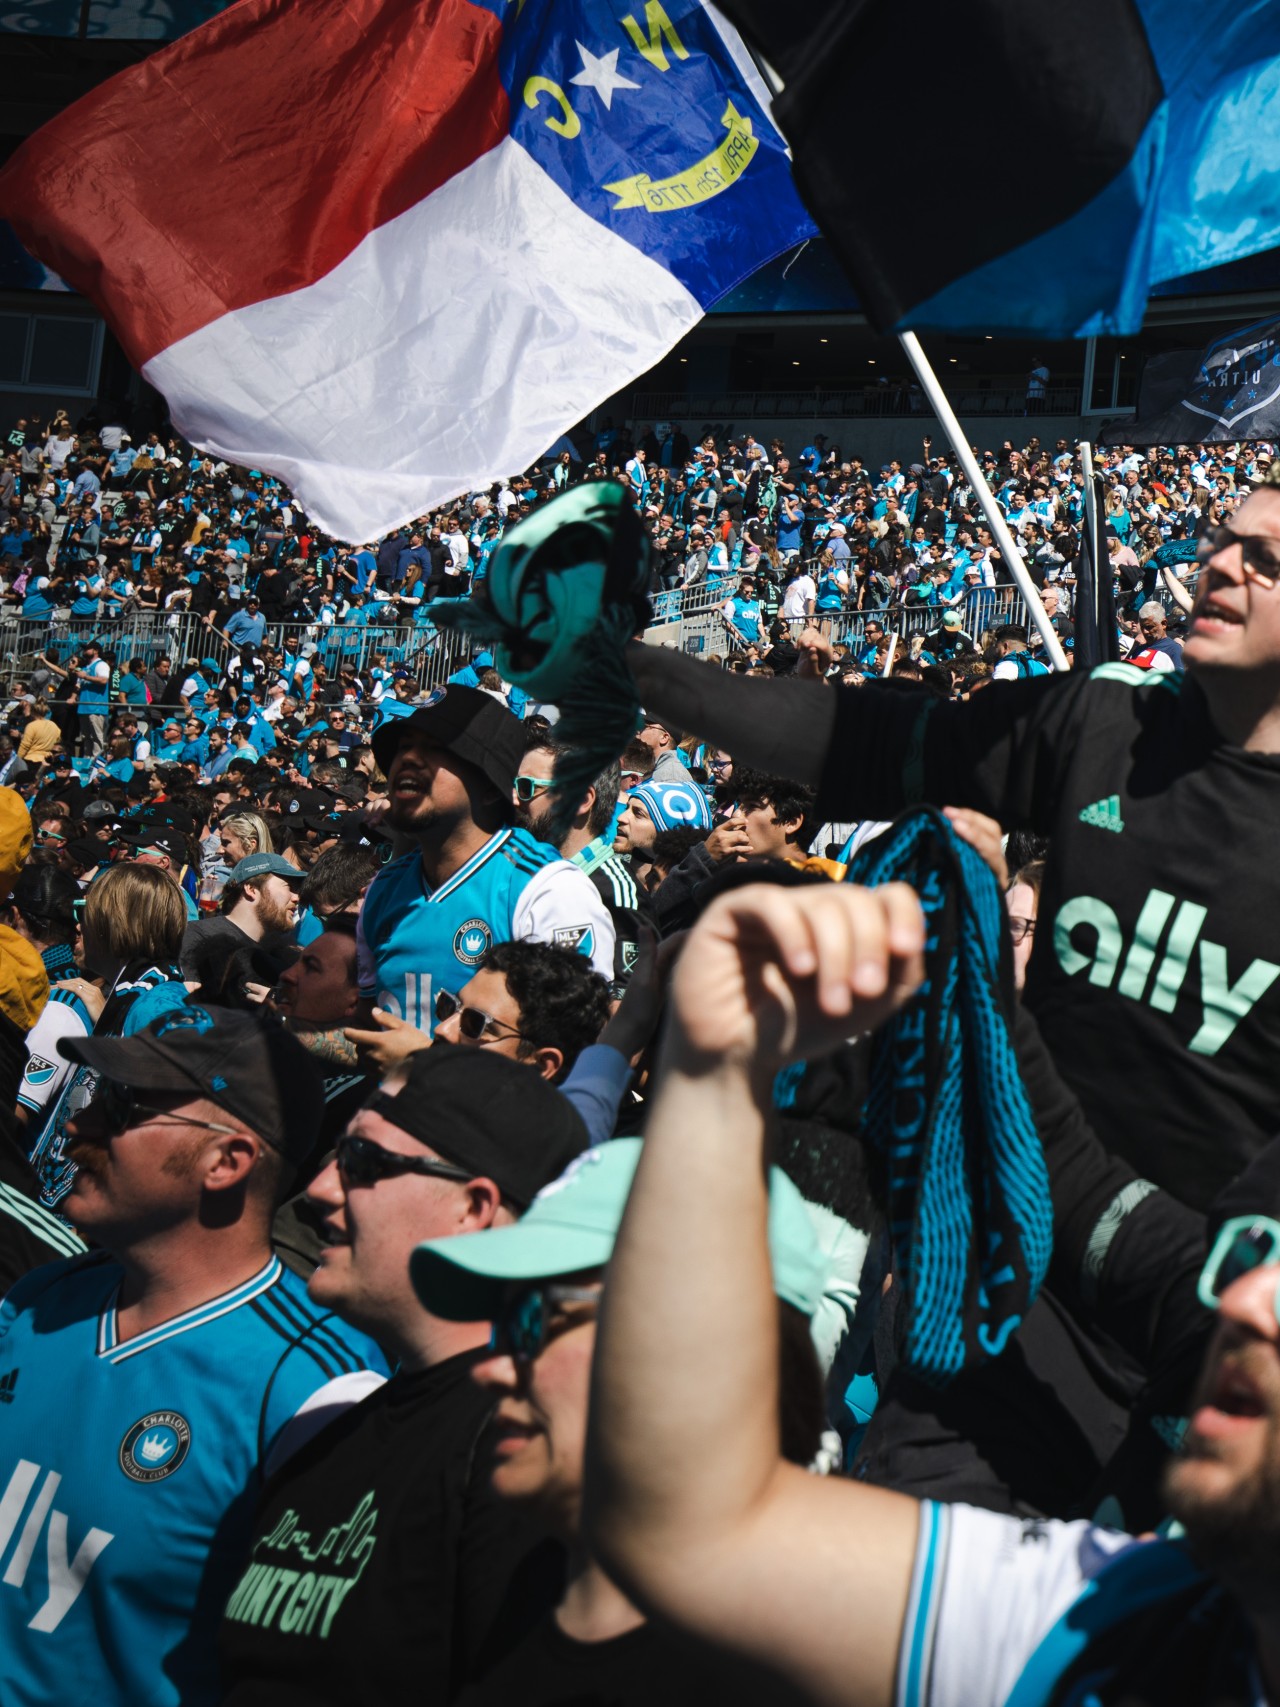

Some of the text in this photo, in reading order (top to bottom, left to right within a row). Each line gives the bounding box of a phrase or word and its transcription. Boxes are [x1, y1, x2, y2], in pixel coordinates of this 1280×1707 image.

[8, 433, 25, 447] 45
[460, 919, 490, 936] CHARLOTTE
[558, 930, 580, 944] MLS
[32, 1057, 47, 1070] MLS
[143, 1414, 189, 1442] CHARLOTTE
[0, 1458, 116, 1634] lly
